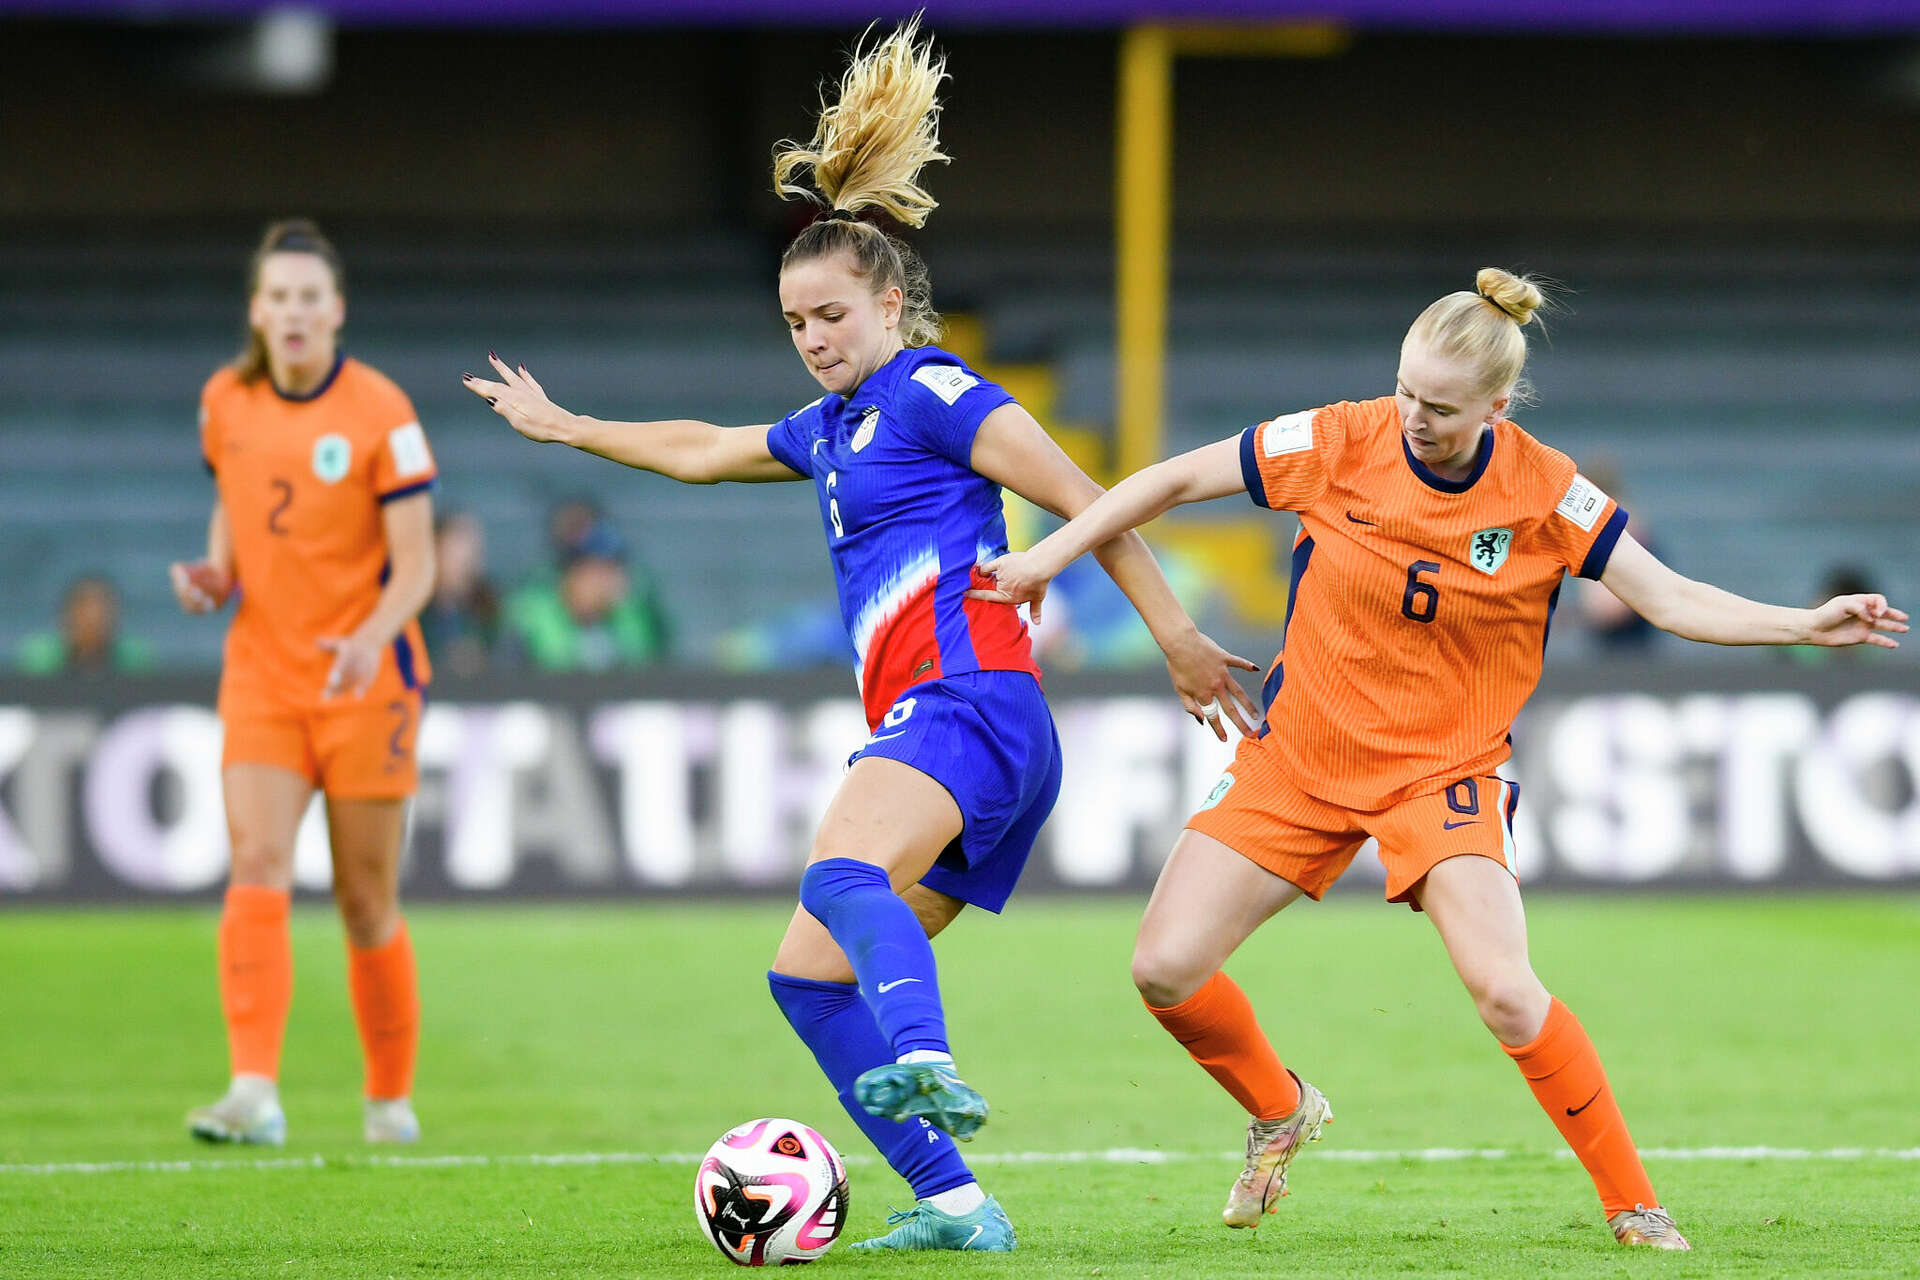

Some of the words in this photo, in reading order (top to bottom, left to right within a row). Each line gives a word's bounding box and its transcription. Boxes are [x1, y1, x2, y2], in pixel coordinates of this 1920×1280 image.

[268, 479, 293, 536] 2
[826, 471, 845, 538] 6
[1402, 559, 1441, 624] 6
[918, 1116, 940, 1144] SA
